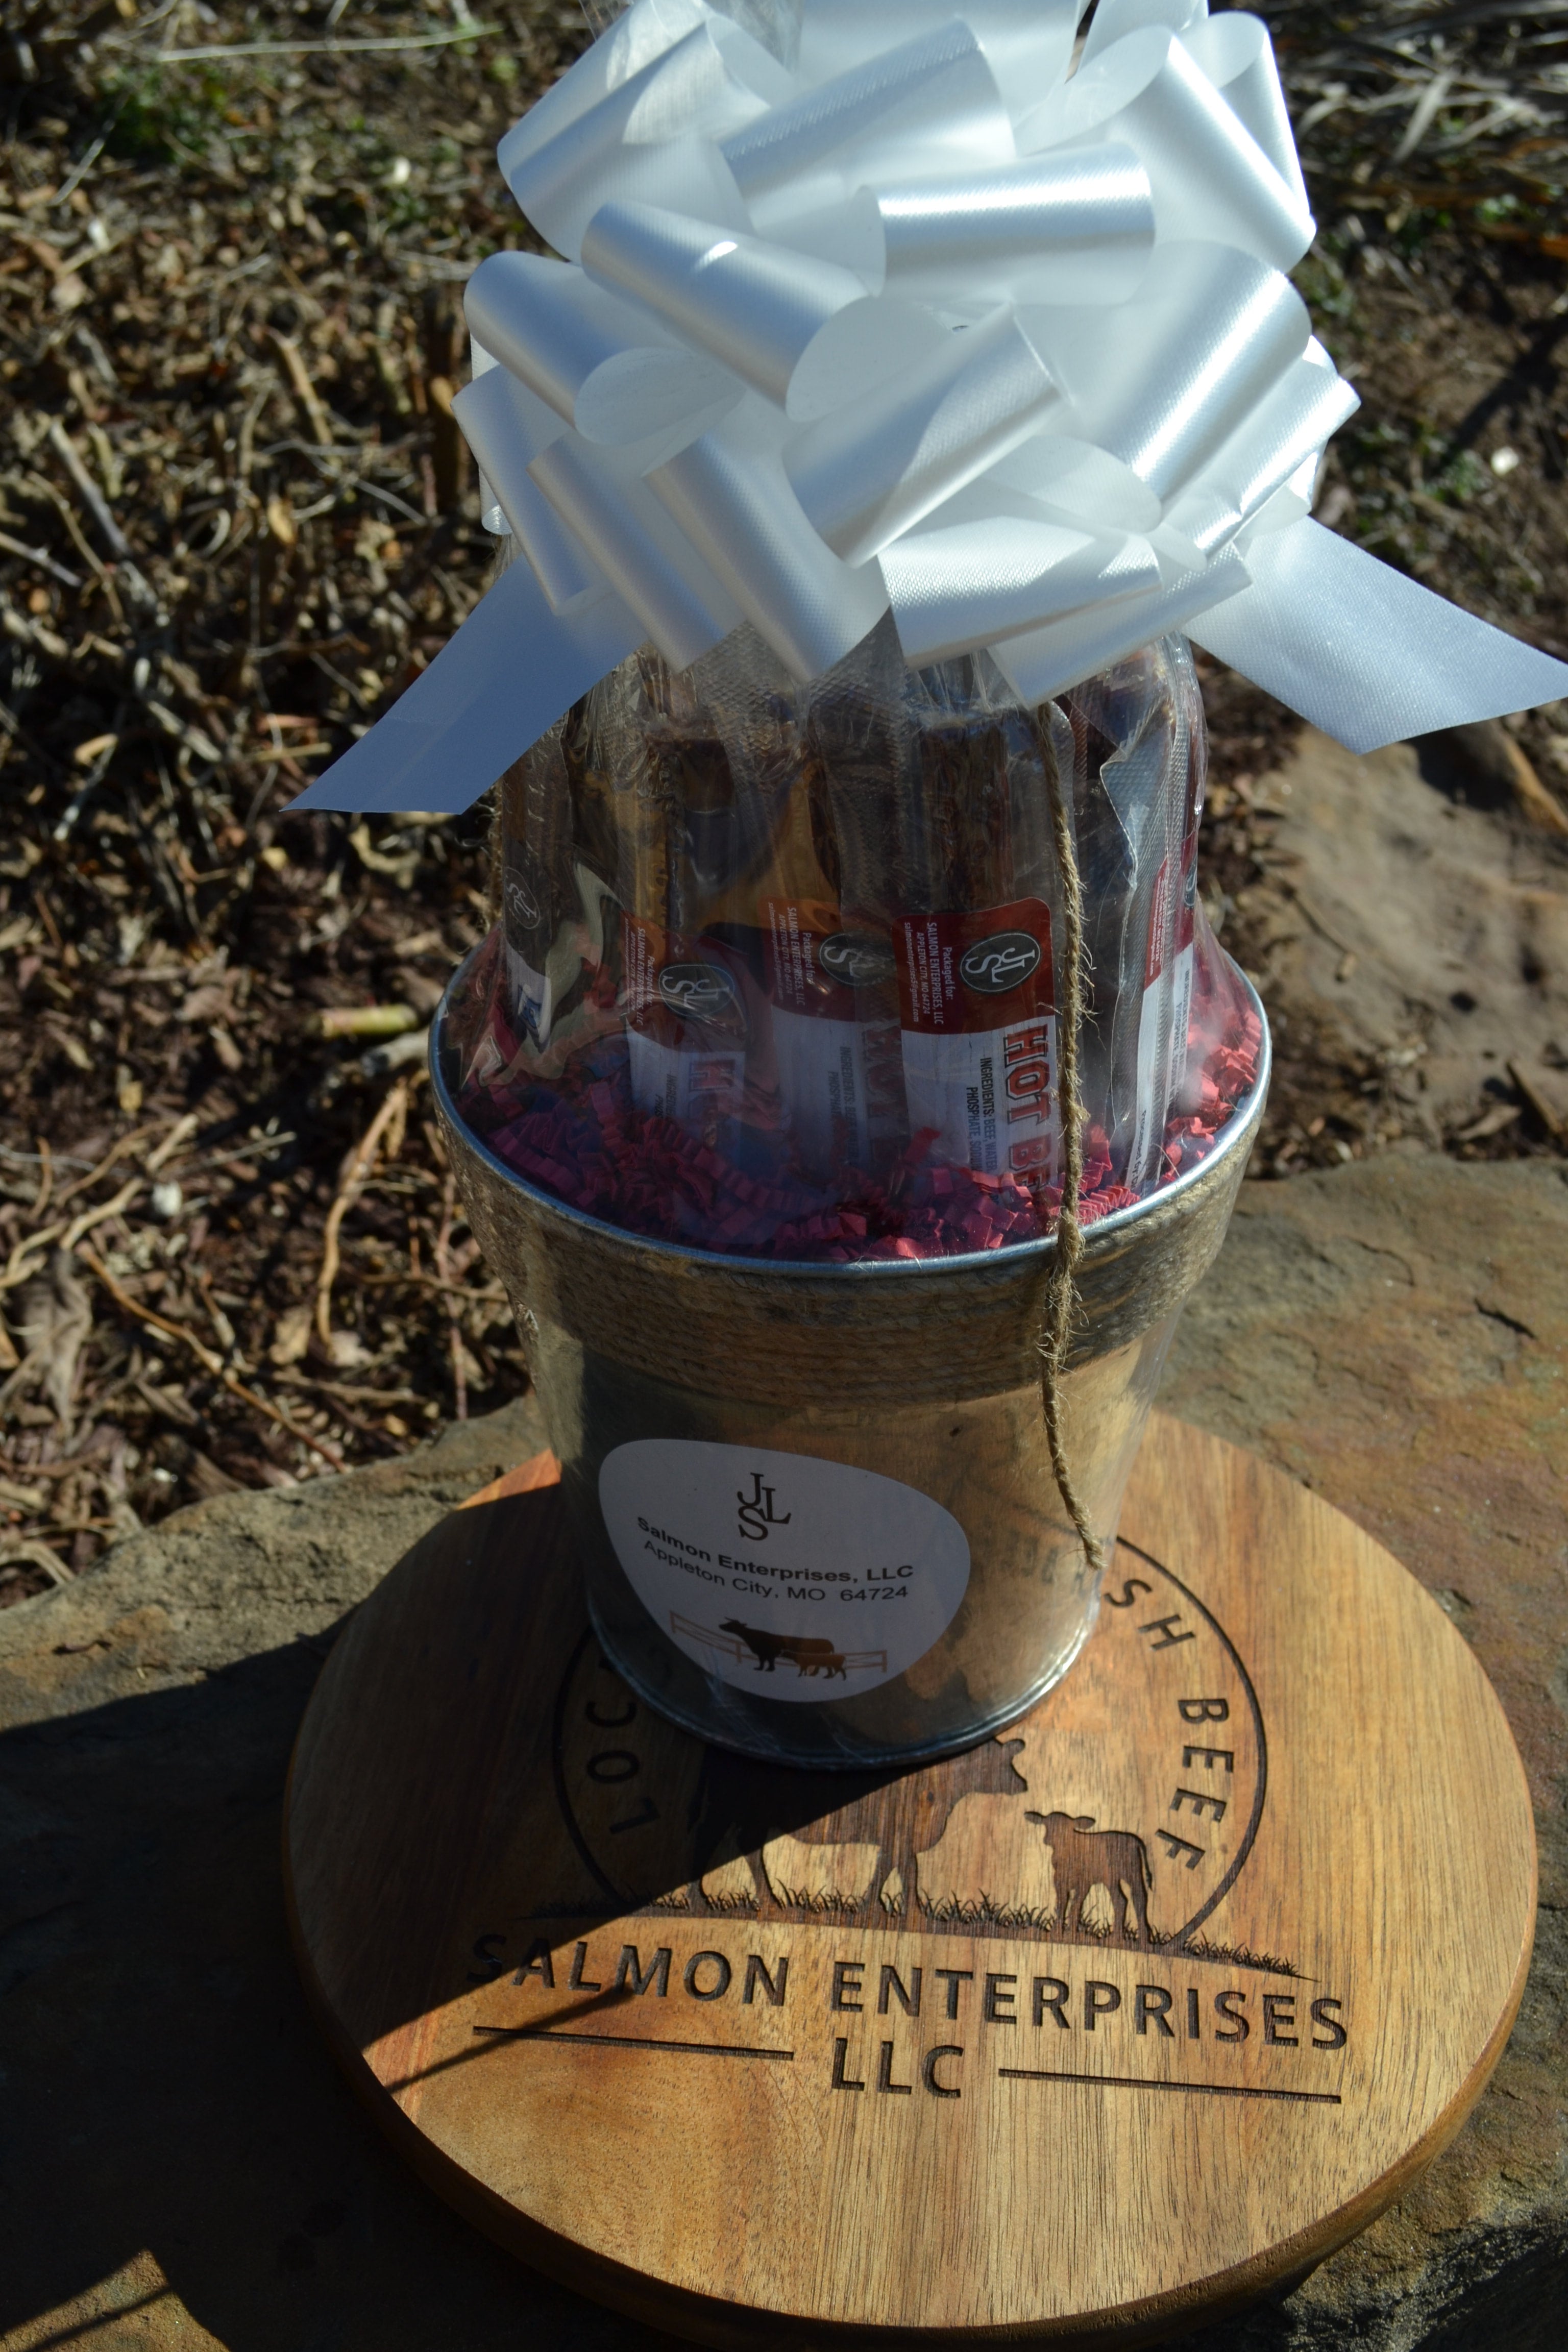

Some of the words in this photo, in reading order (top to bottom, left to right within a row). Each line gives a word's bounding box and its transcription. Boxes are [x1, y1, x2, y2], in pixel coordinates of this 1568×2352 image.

[778, 914, 788, 946] APPLETON
[787, 907, 799, 939] SALMON
[927, 922, 939, 956] SALMON
[790, 941, 803, 990] ENTERPRISES,
[802, 933, 815, 968] Packaged
[917, 932, 927, 964] APPLETON
[942, 947, 955, 984] Packaged
[646, 955, 655, 992] Packaged
[904, 922, 920, 1022] salmonenterprises5@gmail.com
[919, 966, 928, 980] CITY,
[921, 982, 929, 992] MO
[930, 959, 943, 1010] ENTERPRISES,
[796, 993, 805, 1006] LLC
[922, 994, 930, 1014] 64724
[945, 986, 956, 1000] for:
[934, 1012, 944, 1024] LLC
[980, 1057, 995, 1117] INGREDIENTS:
[1004, 1024, 1051, 1125] HOT
[966, 1087, 981, 1140] PHOSPHATE,
[983, 1118, 996, 1142] BEEF,
[637, 1517, 711, 1562] Salmon
[718, 1555, 858, 1583] Enterprises,
[867, 1565, 914, 1582] LLC
[643, 1539, 725, 1586] Appleton
[732, 1577, 778, 1599] City,
[787, 1586, 826, 1602] MO
[840, 1586, 909, 1602] 64724
[1154, 1698, 1234, 1870] BEEF
[465, 1933, 789, 2007] SALMON
[830, 1961, 1349, 2051] ENTERPRISES
[830, 2037, 964, 2099] LLC
